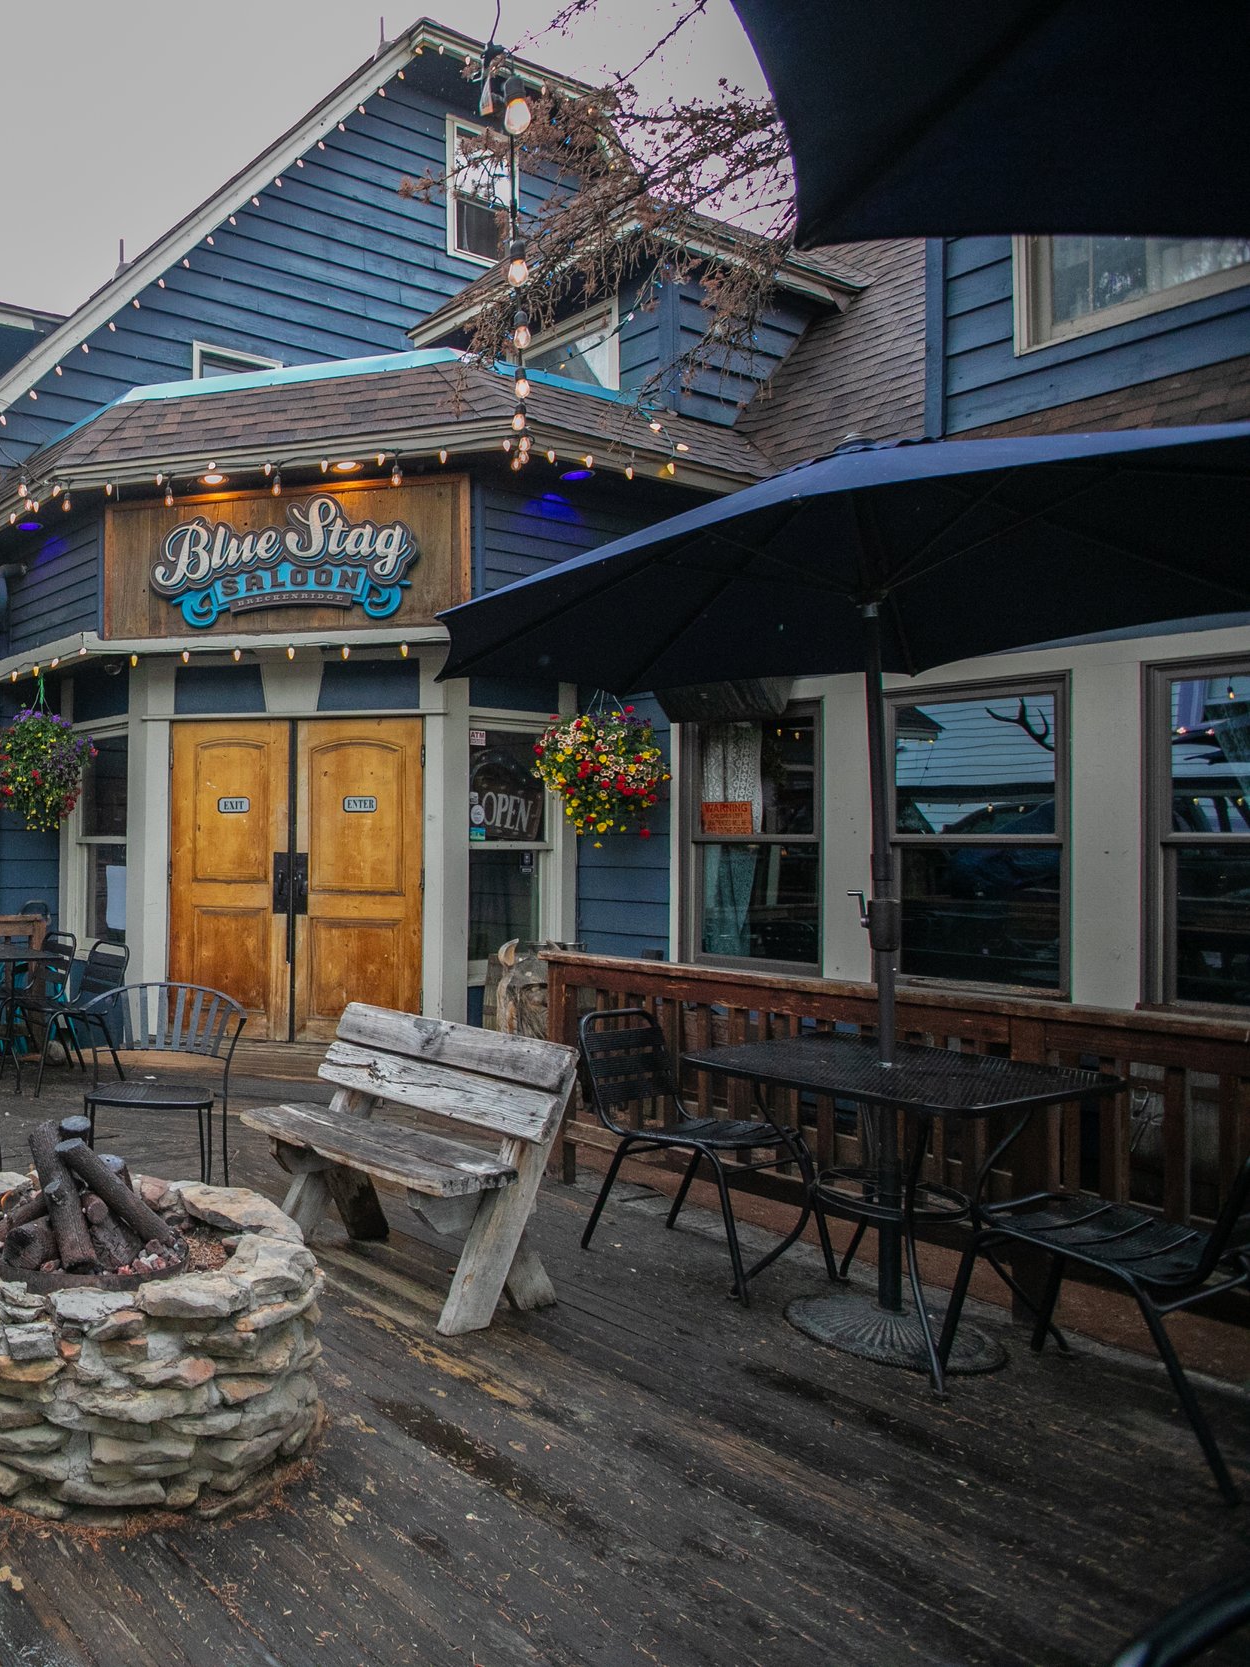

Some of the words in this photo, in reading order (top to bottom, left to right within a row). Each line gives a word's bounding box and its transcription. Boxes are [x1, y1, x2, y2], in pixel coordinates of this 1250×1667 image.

[154, 520, 280, 587] Blue
[284, 498, 409, 575] Stag
[221, 568, 361, 597] SALOON
[237, 592, 344, 606] BRECKENRIDGE
[223, 800, 245, 810] EXIT
[347, 799, 374, 809] ENTER
[704, 803, 748, 813] WARNING
[482, 791, 533, 833] OPEN
